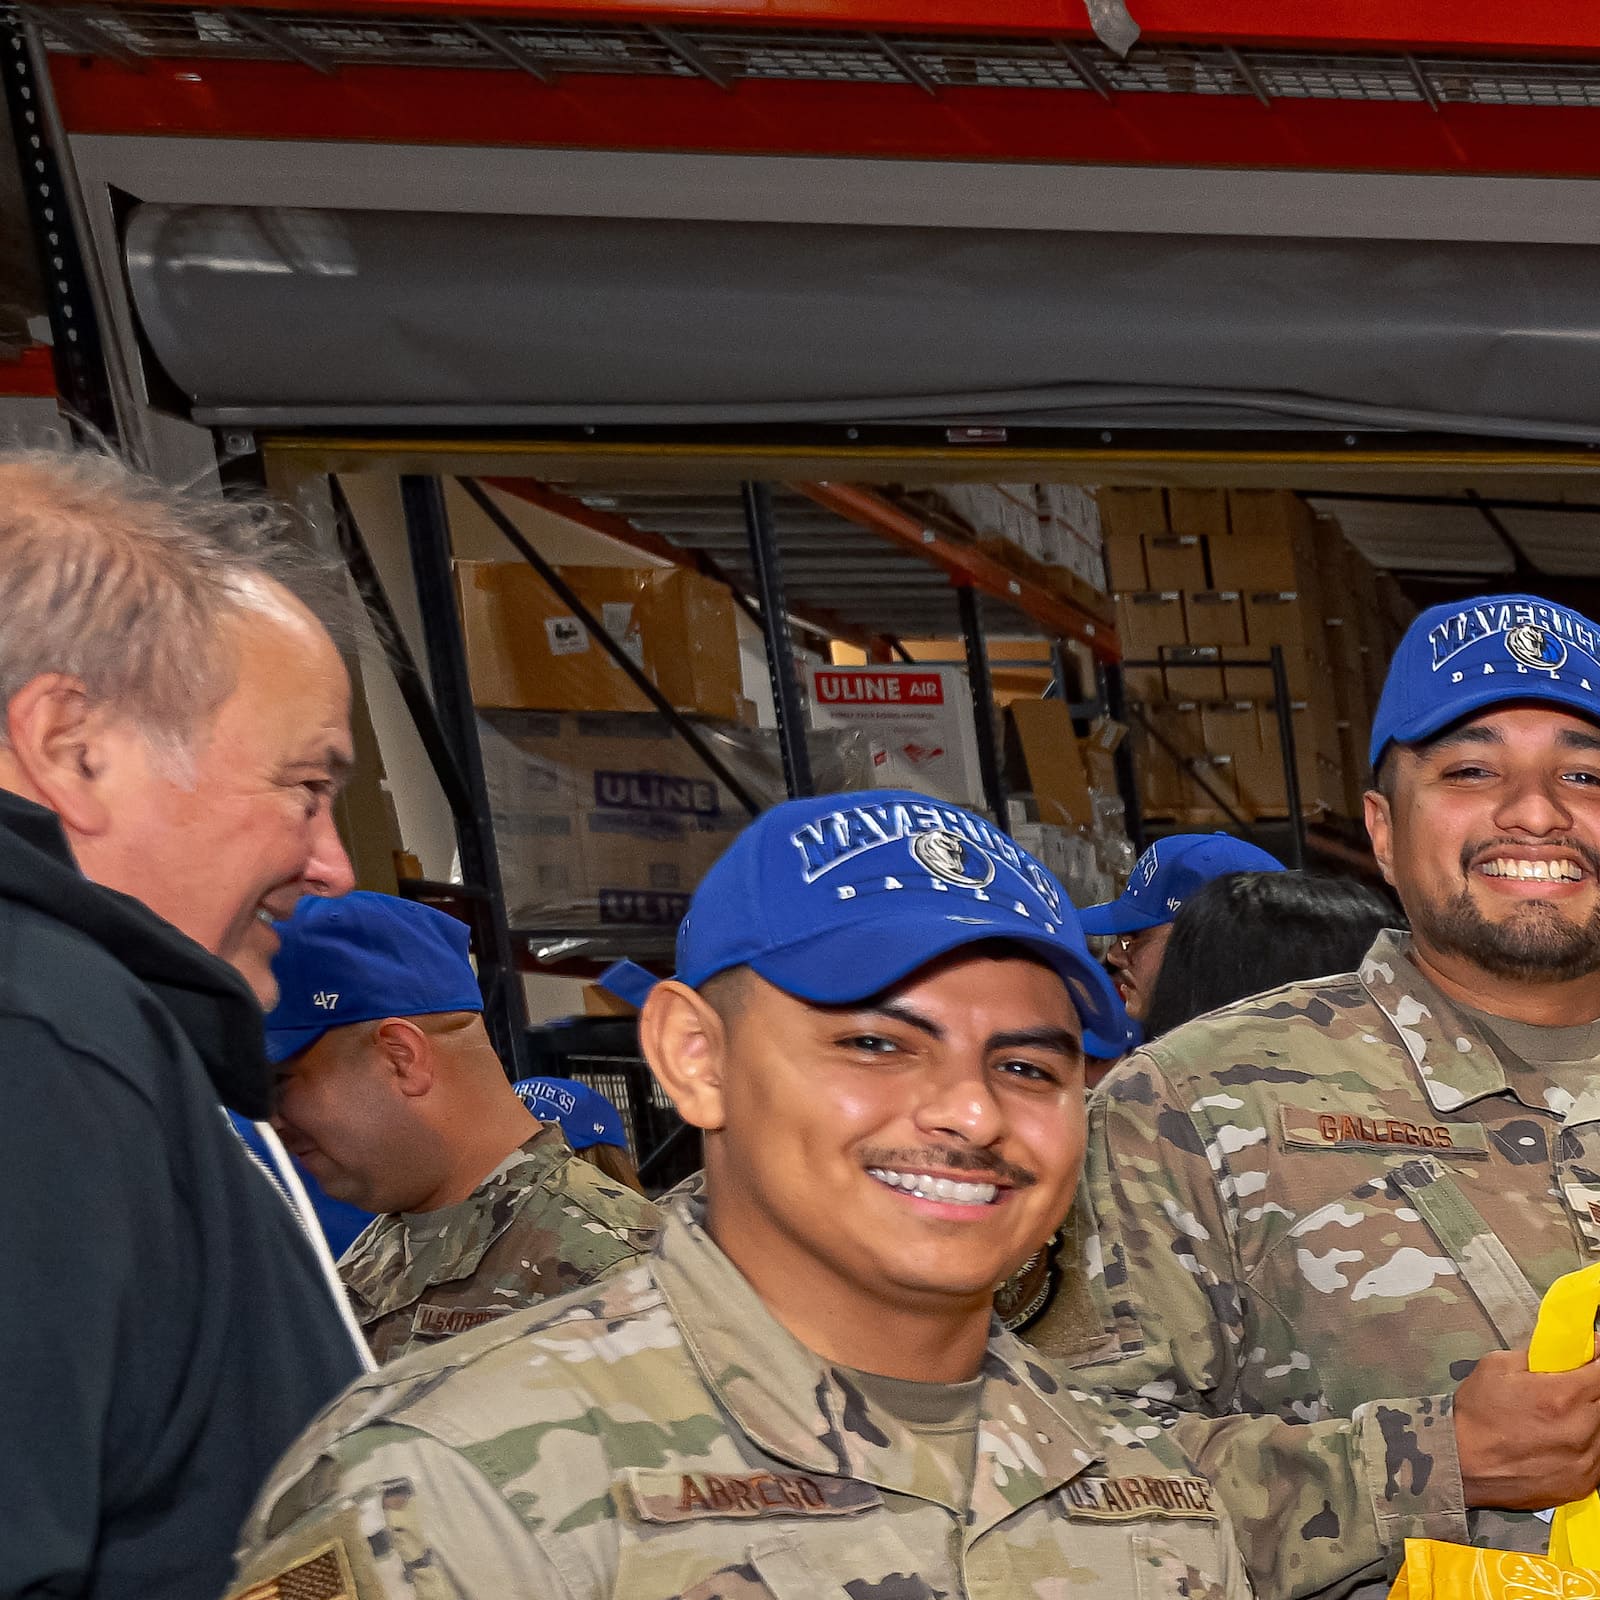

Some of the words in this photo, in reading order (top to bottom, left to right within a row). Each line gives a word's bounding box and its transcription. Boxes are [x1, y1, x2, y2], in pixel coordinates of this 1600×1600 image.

[821, 671, 900, 700] ULINE
[910, 682, 938, 698] AIR
[601, 776, 716, 811] ULINE
[312, 990, 340, 1011] 47
[1319, 1113, 1452, 1149] GALLEGOS
[1100, 1478, 1143, 1513] AIR
[1143, 1476, 1216, 1512] FORCE
